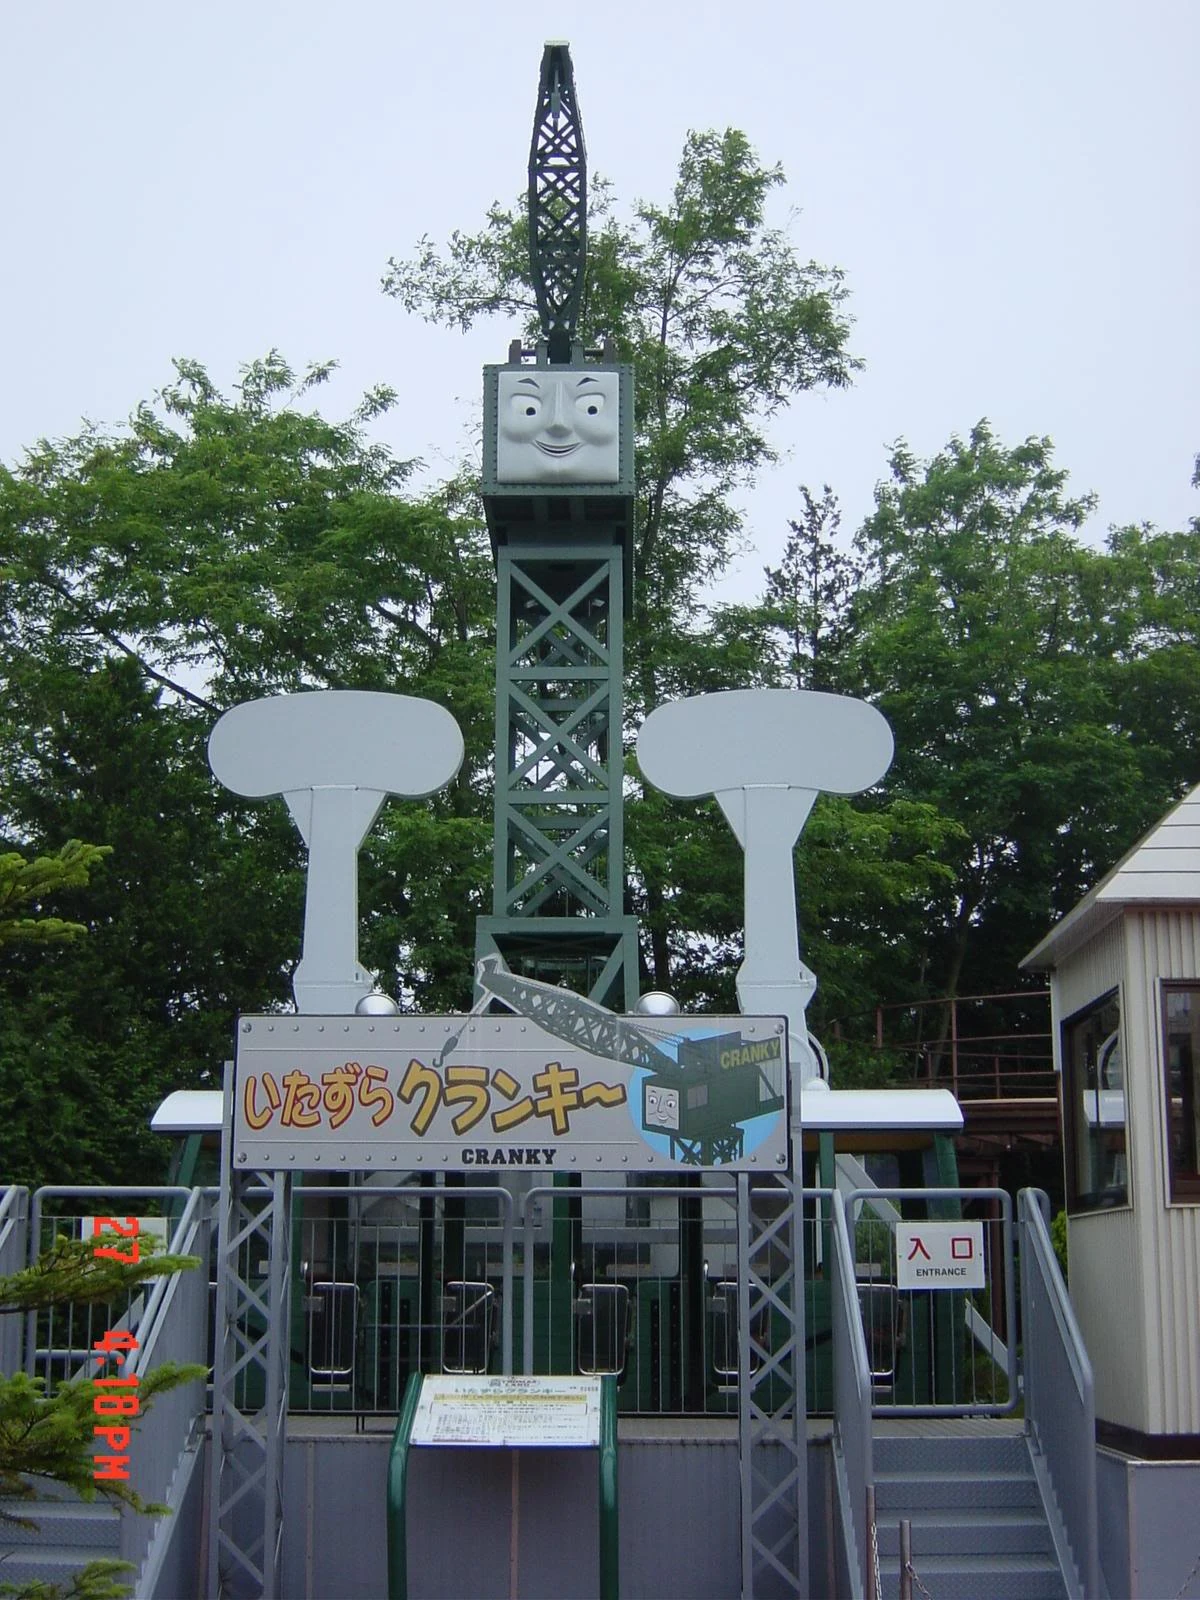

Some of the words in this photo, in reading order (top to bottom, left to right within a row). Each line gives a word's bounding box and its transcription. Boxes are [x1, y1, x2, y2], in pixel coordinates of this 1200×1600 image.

[720, 1040, 780, 1069] CRANKY
[461, 1148, 556, 1165] CRANKY
[908, 1237, 973, 1260] 入口
[916, 1267, 967, 1277] ENTRANCE
